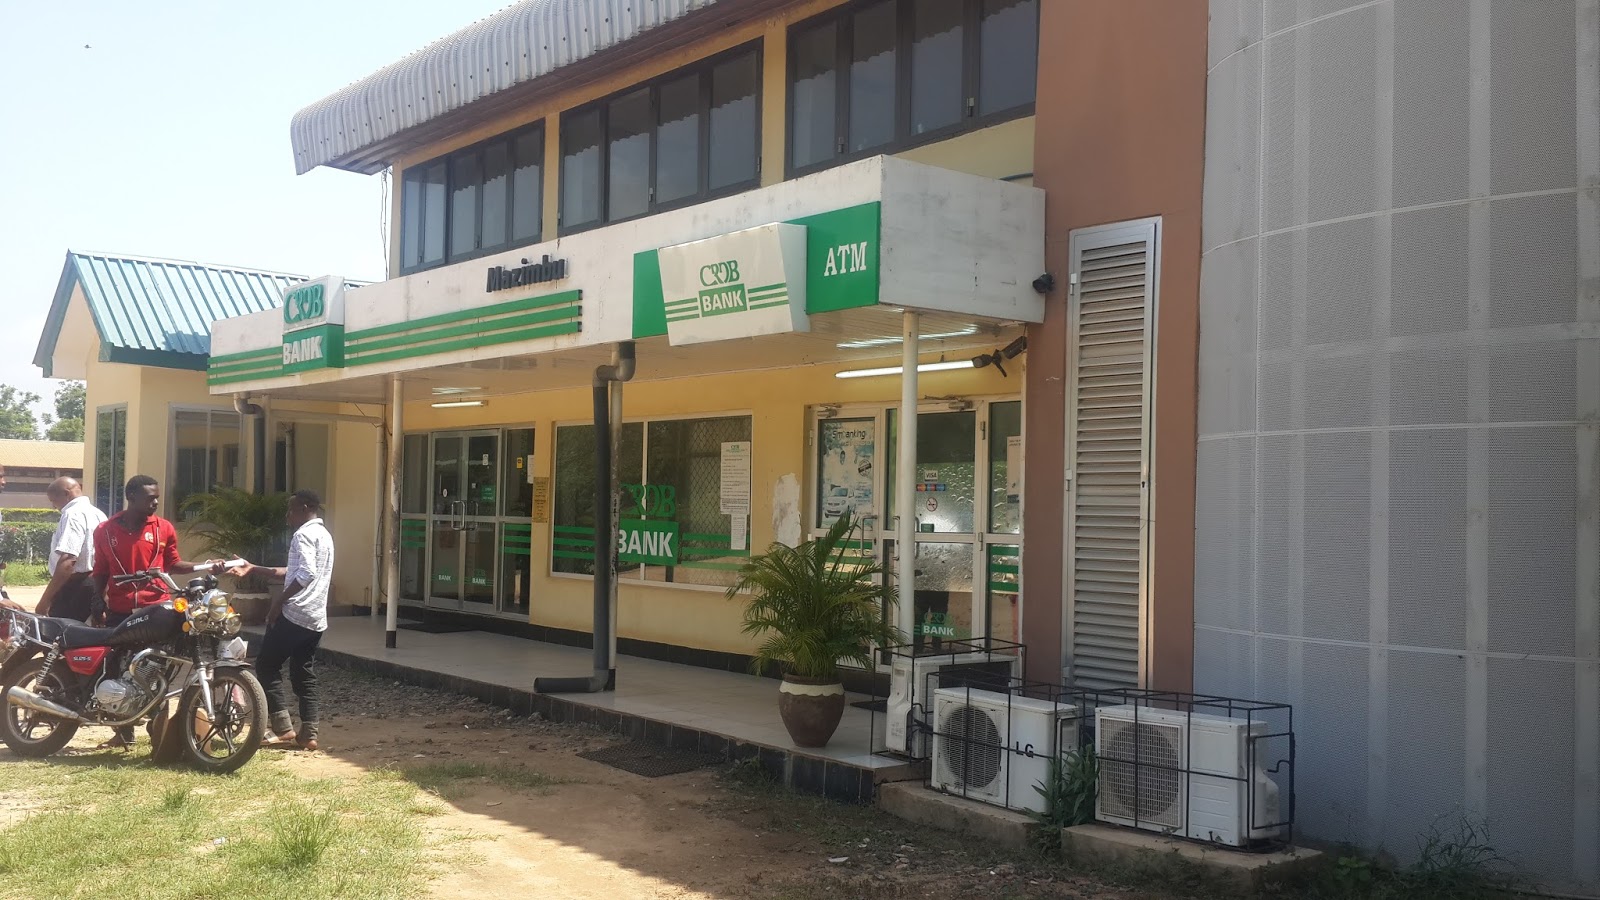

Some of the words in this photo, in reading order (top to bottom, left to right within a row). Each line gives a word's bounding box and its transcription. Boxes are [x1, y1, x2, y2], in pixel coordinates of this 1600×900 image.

[824, 241, 867, 276] ATM
[486, 255, 565, 292] Mazimbu
[700, 260, 740, 286] CRDB
[284, 284, 324, 324] CRDB
[702, 290, 744, 312] BANK
[283, 336, 323, 365] BANK
[438, 574, 452, 582] BANK
[472, 577, 486, 585] BANK
[923, 625, 954, 636] BANK
[1016, 741, 1034, 759] LG
